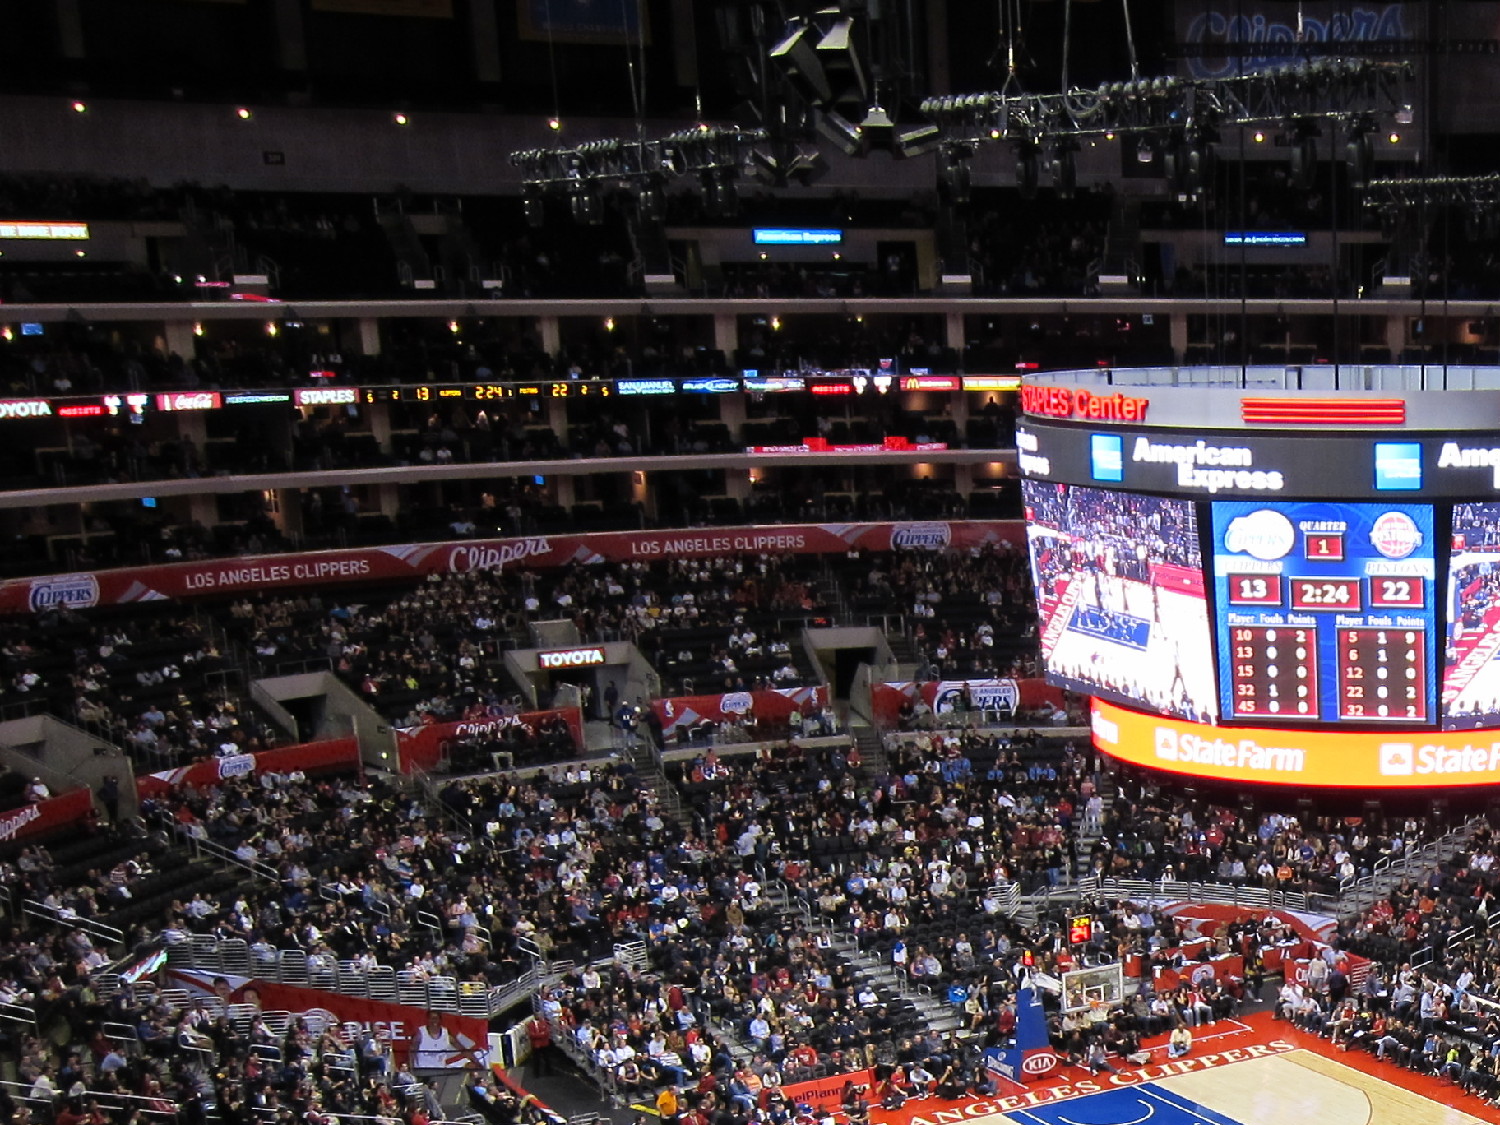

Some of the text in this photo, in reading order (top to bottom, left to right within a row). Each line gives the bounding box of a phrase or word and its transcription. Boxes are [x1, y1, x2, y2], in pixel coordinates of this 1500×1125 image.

[300, 389, 355, 405] STAPLES
[417, 387, 429, 401] 13
[475, 386, 503, 399] 2:24
[552, 383, 567, 397] 22
[0, 402, 52, 418] OYOTA
[1022, 385, 1149, 421] STAPLES Center
[1133, 437, 1252, 467] American
[1177, 463, 1285, 494] Express
[1299, 520, 1347, 532] QUARTER
[632, 535, 806, 554] LOS ANGELES CLIPPERS
[1319, 540, 1330, 554] 1
[449, 538, 553, 576] Clippers
[186, 560, 370, 589] LOS ANGELES CLIPPERS
[1240, 579, 1267, 598] 13
[1302, 584, 1350, 604] 2:24
[1382, 581, 1411, 601] 22
[31, 584, 94, 609] CLIPPERS
[1228, 613, 1317, 625] Player Fouls Points
[1336, 614, 1424, 627] Player Fouls Points
[1236, 630, 1253, 641] 10
[1295, 630, 1306, 643] 2
[1348, 632, 1358, 643] 5
[1377, 632, 1387, 644] 1
[545, 650, 609, 667] TOYOTA
[1236, 647, 1253, 659] 13
[1349, 650, 1415, 662] 6 1 4
[1237, 665, 1254, 677] 15
[1346, 667, 1363, 679] 12
[1237, 684, 1255, 697] 32
[1269, 684, 1279, 698] 1
[1346, 686, 1364, 698] 22
[1406, 687, 1416, 699] 2
[1238, 701, 1256, 712] 45
[1346, 705, 1364, 716] 32
[1406, 706, 1416, 717] 2
[1178, 733, 1304, 771] StateFarm
[0, 803, 41, 841] ippers
[1071, 927, 1091, 943] 24
[1028, 1056, 1052, 1071] KIA
[1109, 1039, 1295, 1087] CLIPPERS
